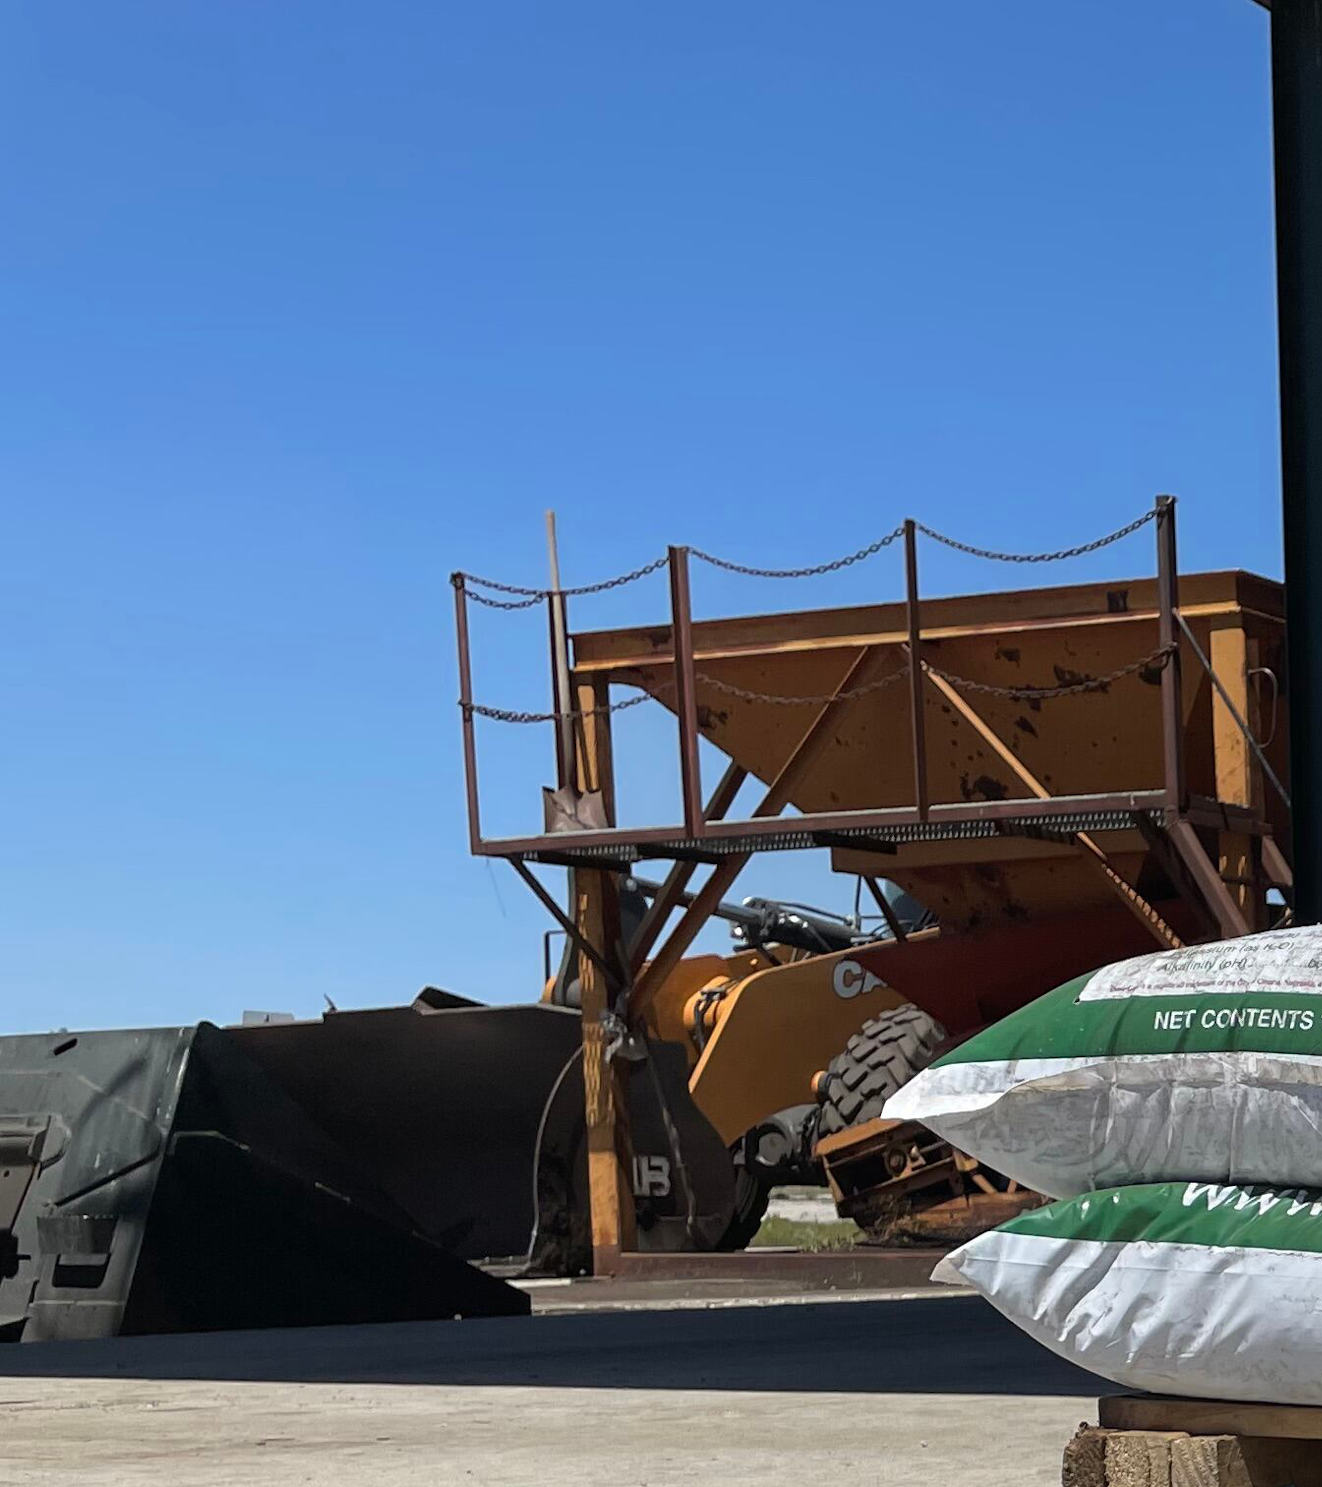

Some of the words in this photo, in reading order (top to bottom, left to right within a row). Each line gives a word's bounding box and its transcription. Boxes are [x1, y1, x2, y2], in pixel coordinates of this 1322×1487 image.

[833, 960, 888, 999] CA
[1154, 1009, 1195, 1030] NET
[1201, 1009, 1313, 1030] CONTENTS
